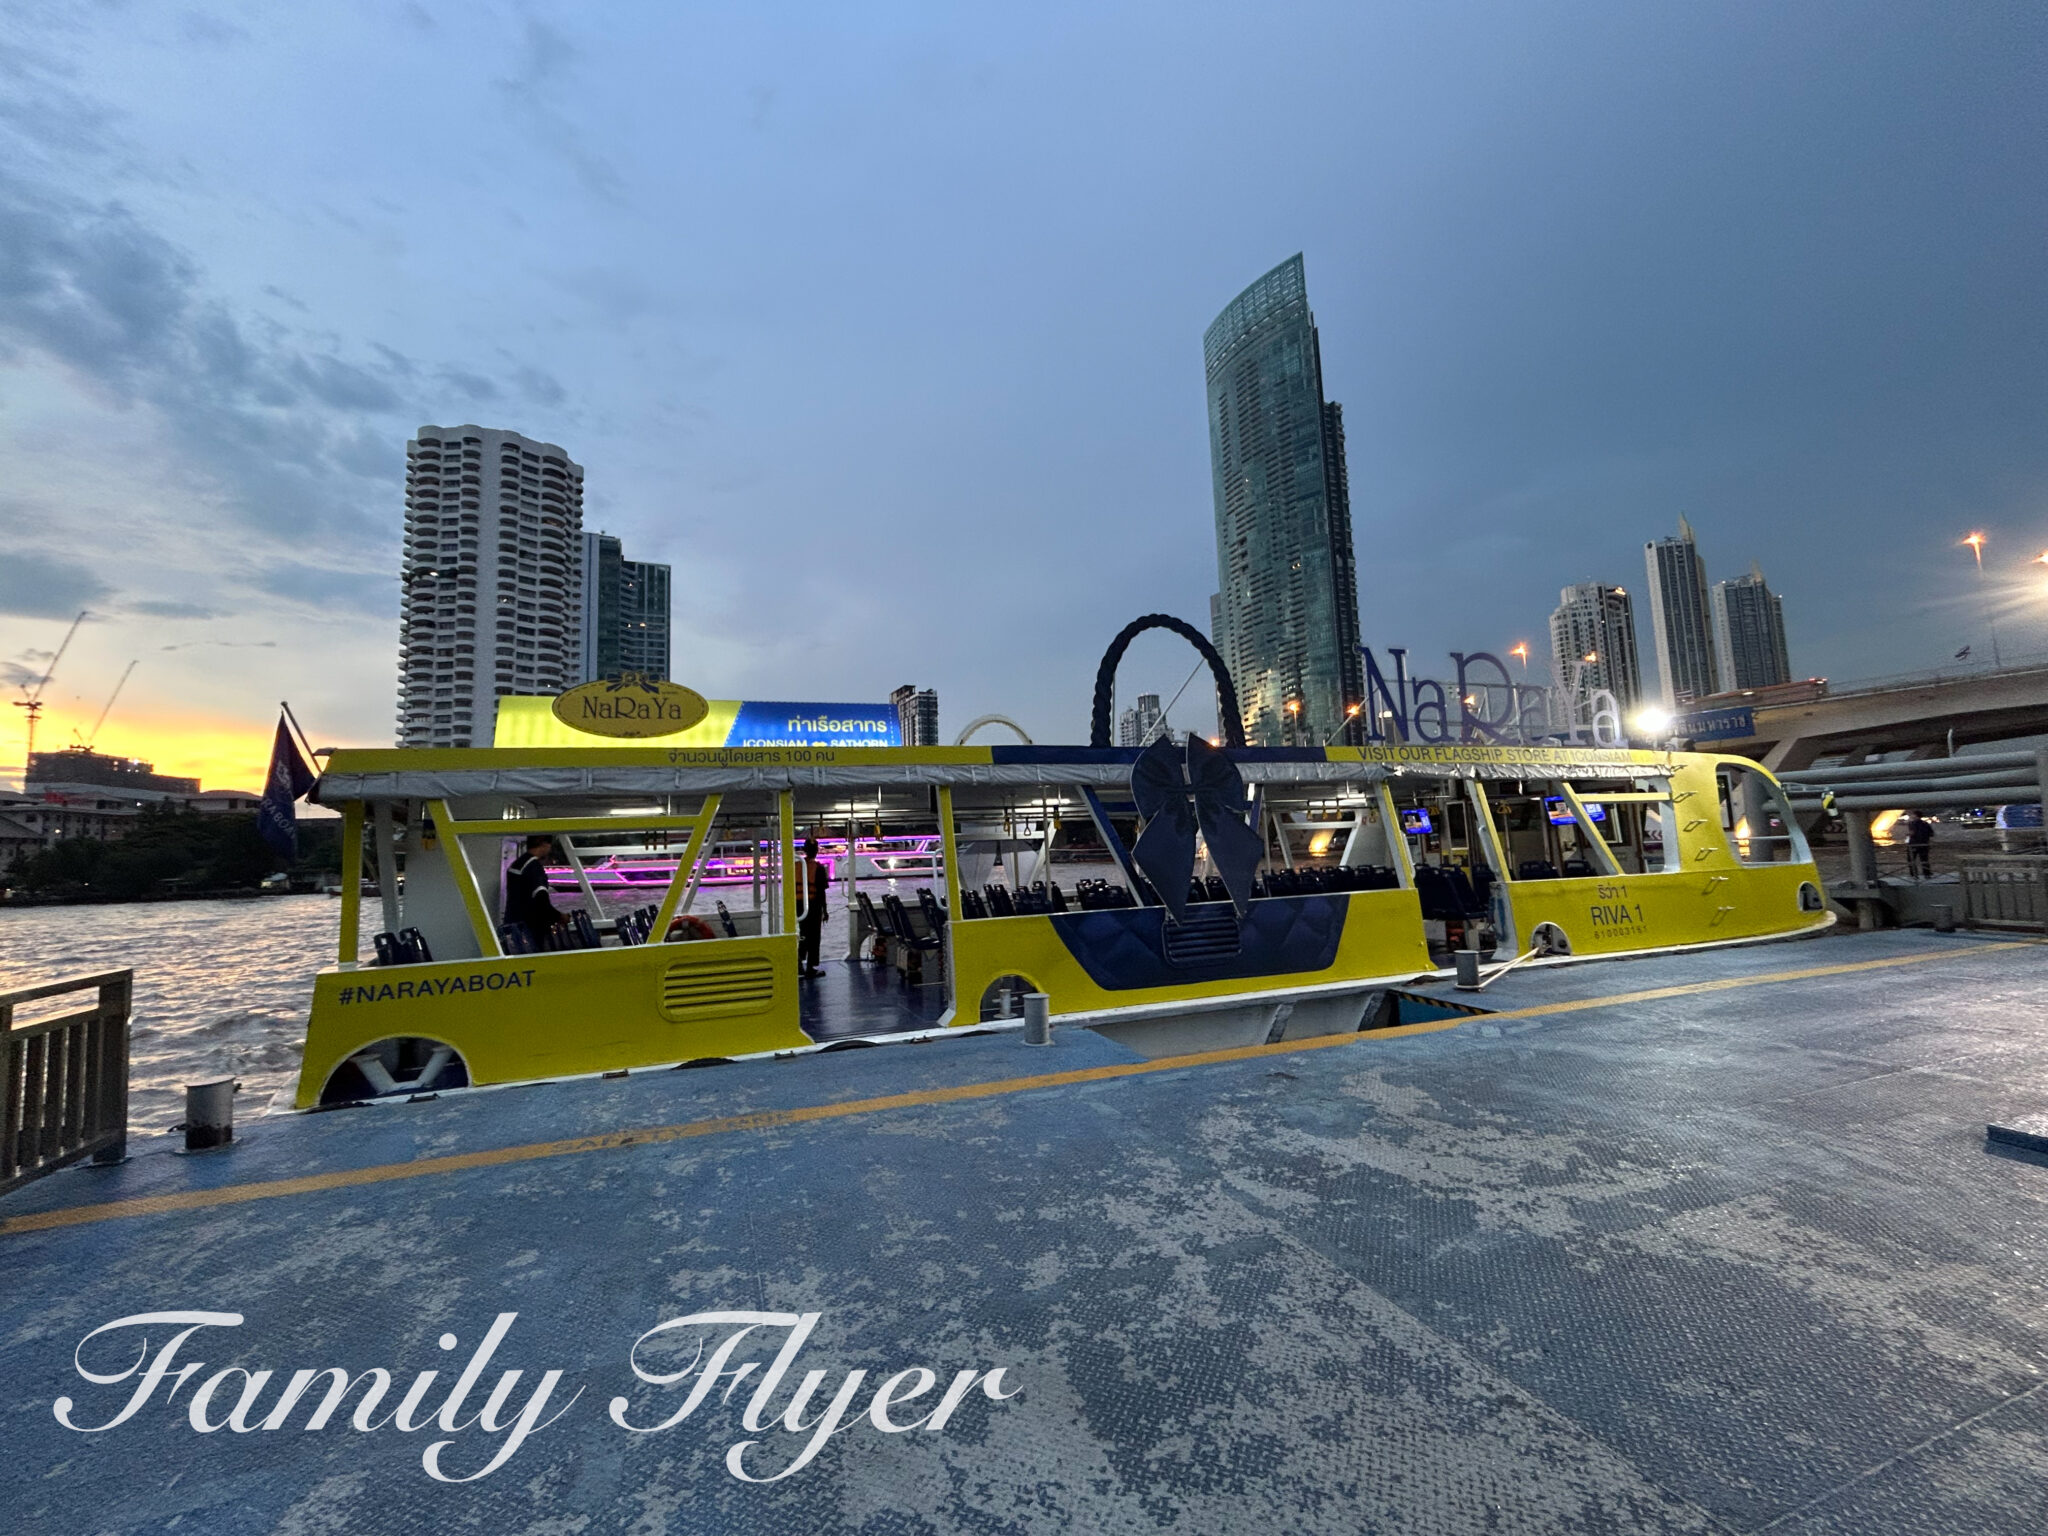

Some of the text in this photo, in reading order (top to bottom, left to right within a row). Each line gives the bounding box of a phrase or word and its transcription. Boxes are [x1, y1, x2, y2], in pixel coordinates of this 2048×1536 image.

[582, 695, 682, 720] NaRaYa
[1355, 646, 1629, 749] NaRaYa
[787, 715, 888, 733] ท่าเรือสาทร
[668, 747, 835, 769] จำนวนผู้โดยสาร 100 คน
[1357, 747, 1632, 762] VISIT OUR FLAGSHIP STORE AT ICONSIAM
[1620, 884, 1628, 898] 1
[1590, 903, 1644, 926] RIVA 1
[338, 969, 536, 1005] #NARAYABOAT
